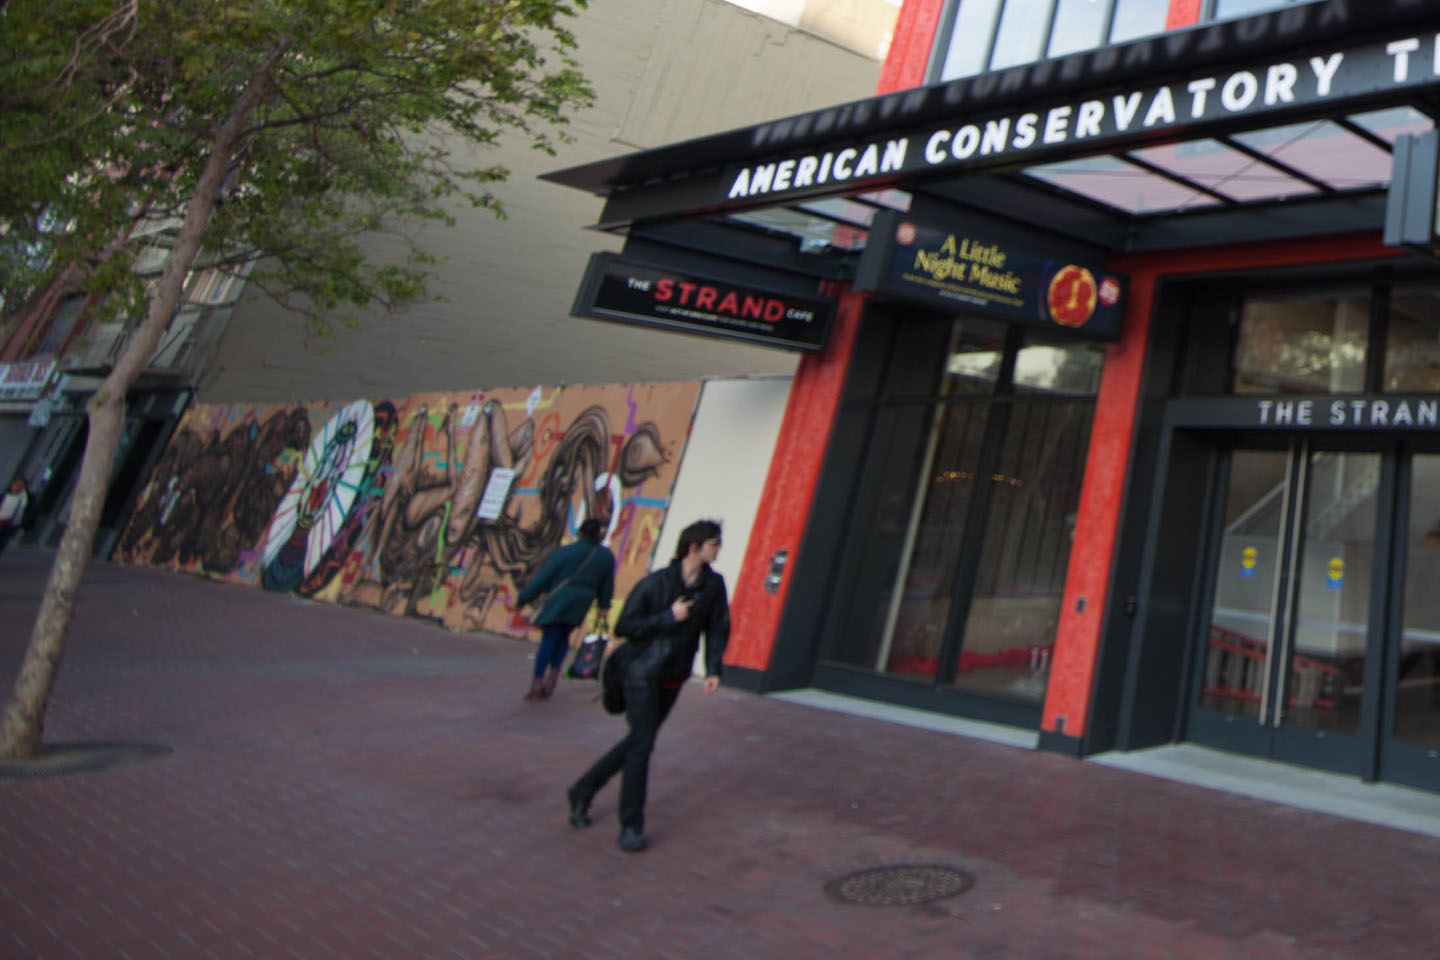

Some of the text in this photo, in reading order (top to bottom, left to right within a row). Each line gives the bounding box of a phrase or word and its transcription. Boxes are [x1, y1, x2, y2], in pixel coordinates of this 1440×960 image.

[728, 138, 908, 199] AMERICAN
[925, 52, 1344, 165] CONSERVATORY
[913, 249, 968, 281] Night
[968, 262, 1022, 294] Music
[939, 234, 956, 256] A
[959, 238, 1008, 269] Little
[627, 277, 652, 292] THE
[653, 277, 786, 324] STRAND
[1257, 400, 1314, 426] THE
